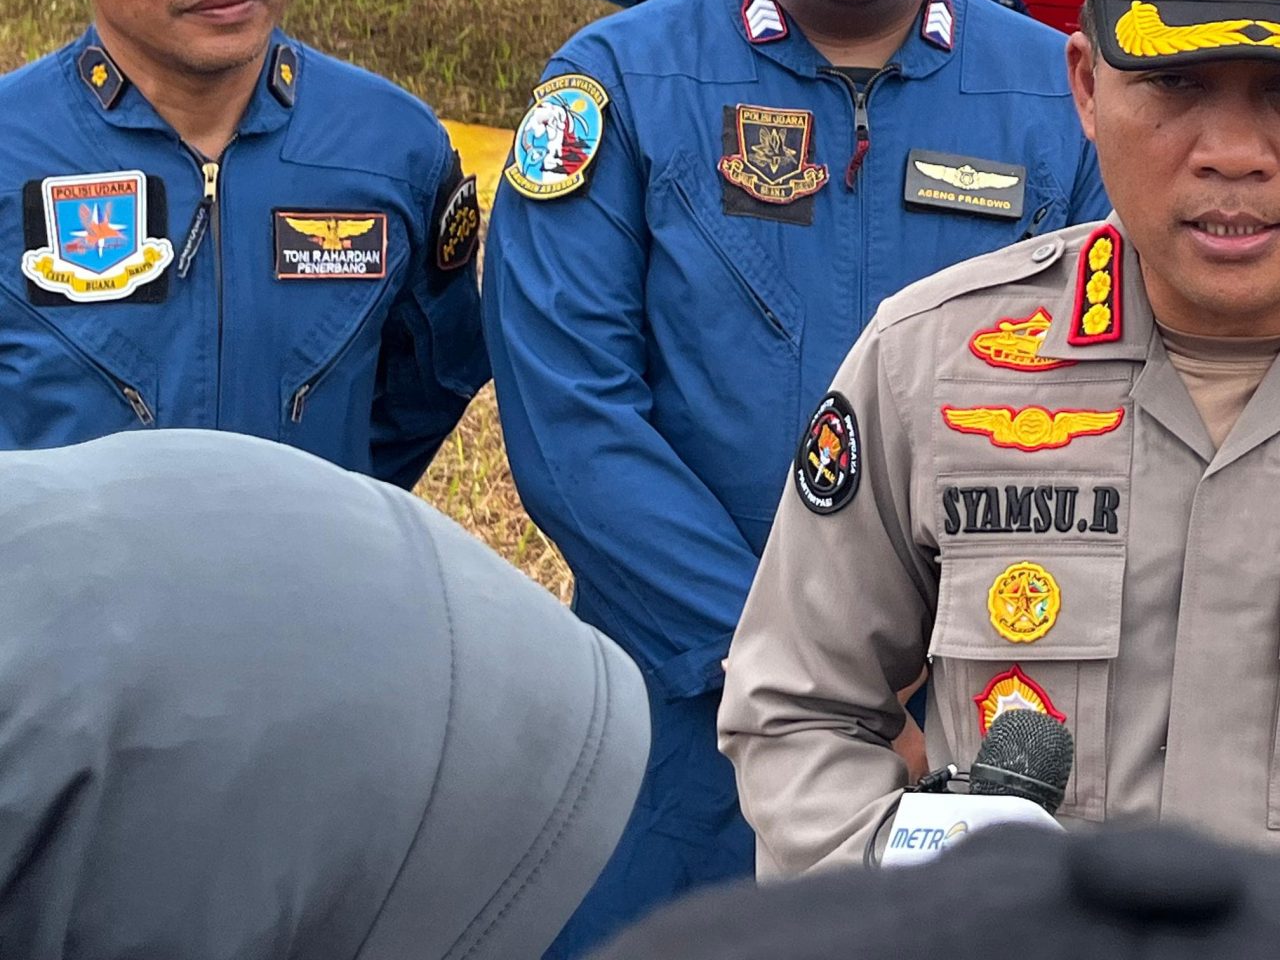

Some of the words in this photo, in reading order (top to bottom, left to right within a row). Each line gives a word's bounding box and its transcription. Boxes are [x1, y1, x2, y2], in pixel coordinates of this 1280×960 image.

[56, 184, 92, 198] POLISI
[94, 182, 133, 195] UDARA
[918, 188, 955, 200] AGENG
[958, 195, 1011, 209] PRABOWO
[283, 249, 310, 263] TONI
[312, 250, 380, 264] RAHARDIAN
[297, 262, 367, 274] PENERBANG
[85, 281, 116, 291] BUANA
[941, 485, 1121, 534] SYAMSU.R
